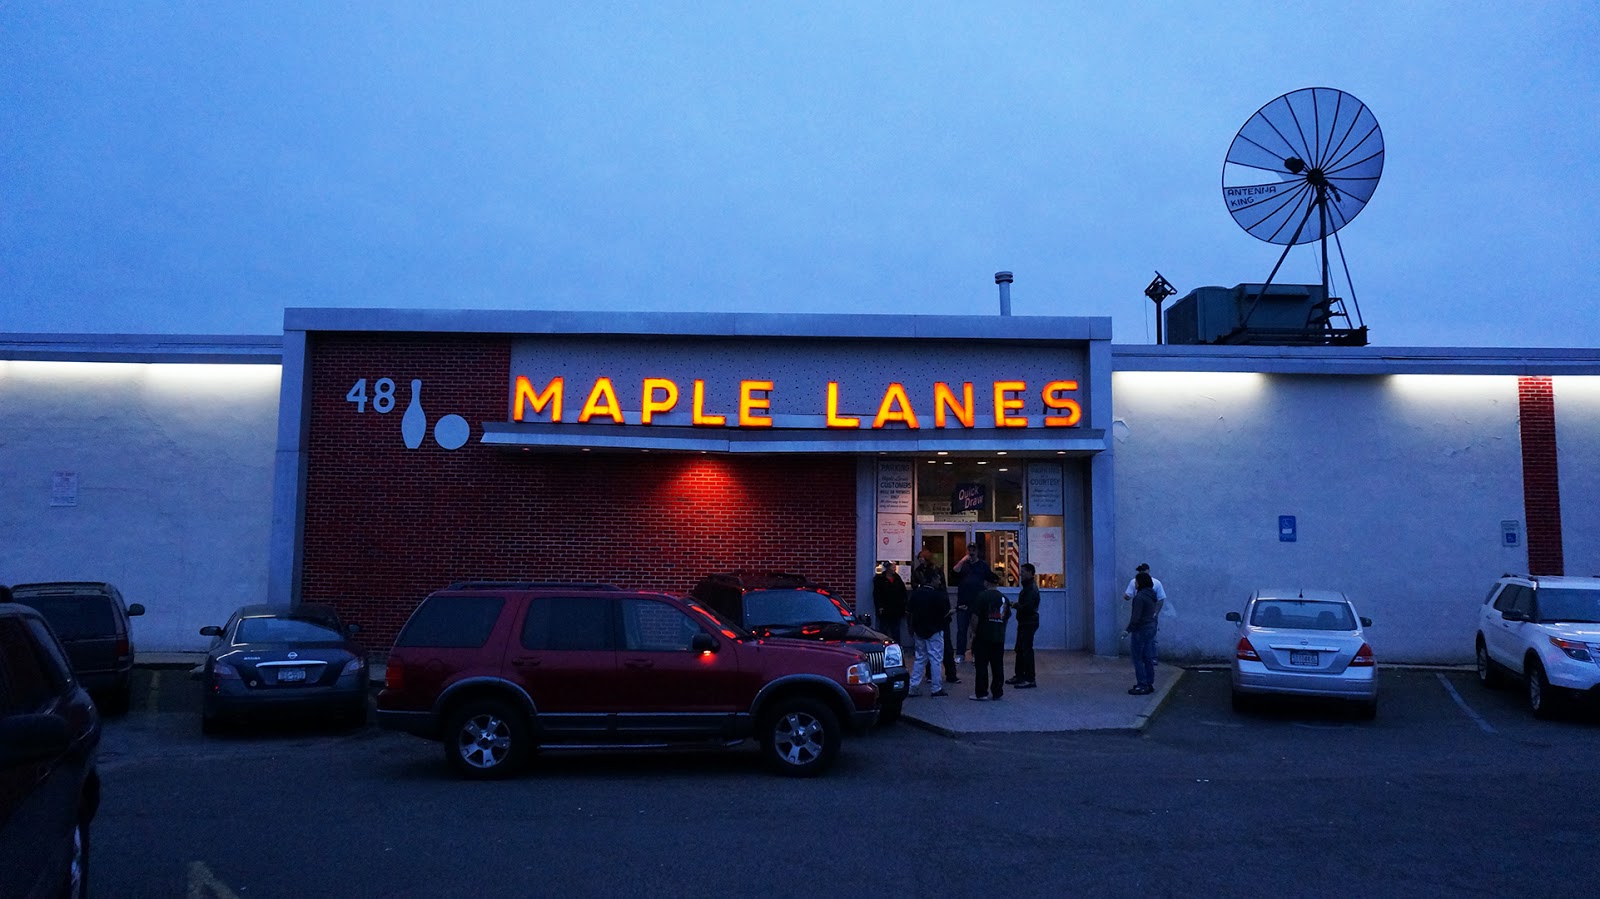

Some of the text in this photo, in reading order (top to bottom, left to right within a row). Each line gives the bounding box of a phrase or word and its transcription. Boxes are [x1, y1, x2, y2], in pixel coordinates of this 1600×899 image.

[1230, 196, 1255, 206] KING
[346, 377, 396, 413] 48
[513, 375, 1082, 429] MAPLE LANES
[881, 464, 910, 472] PARKING
[958, 485, 979, 500] Quick
[964, 495, 984, 509] Draw
